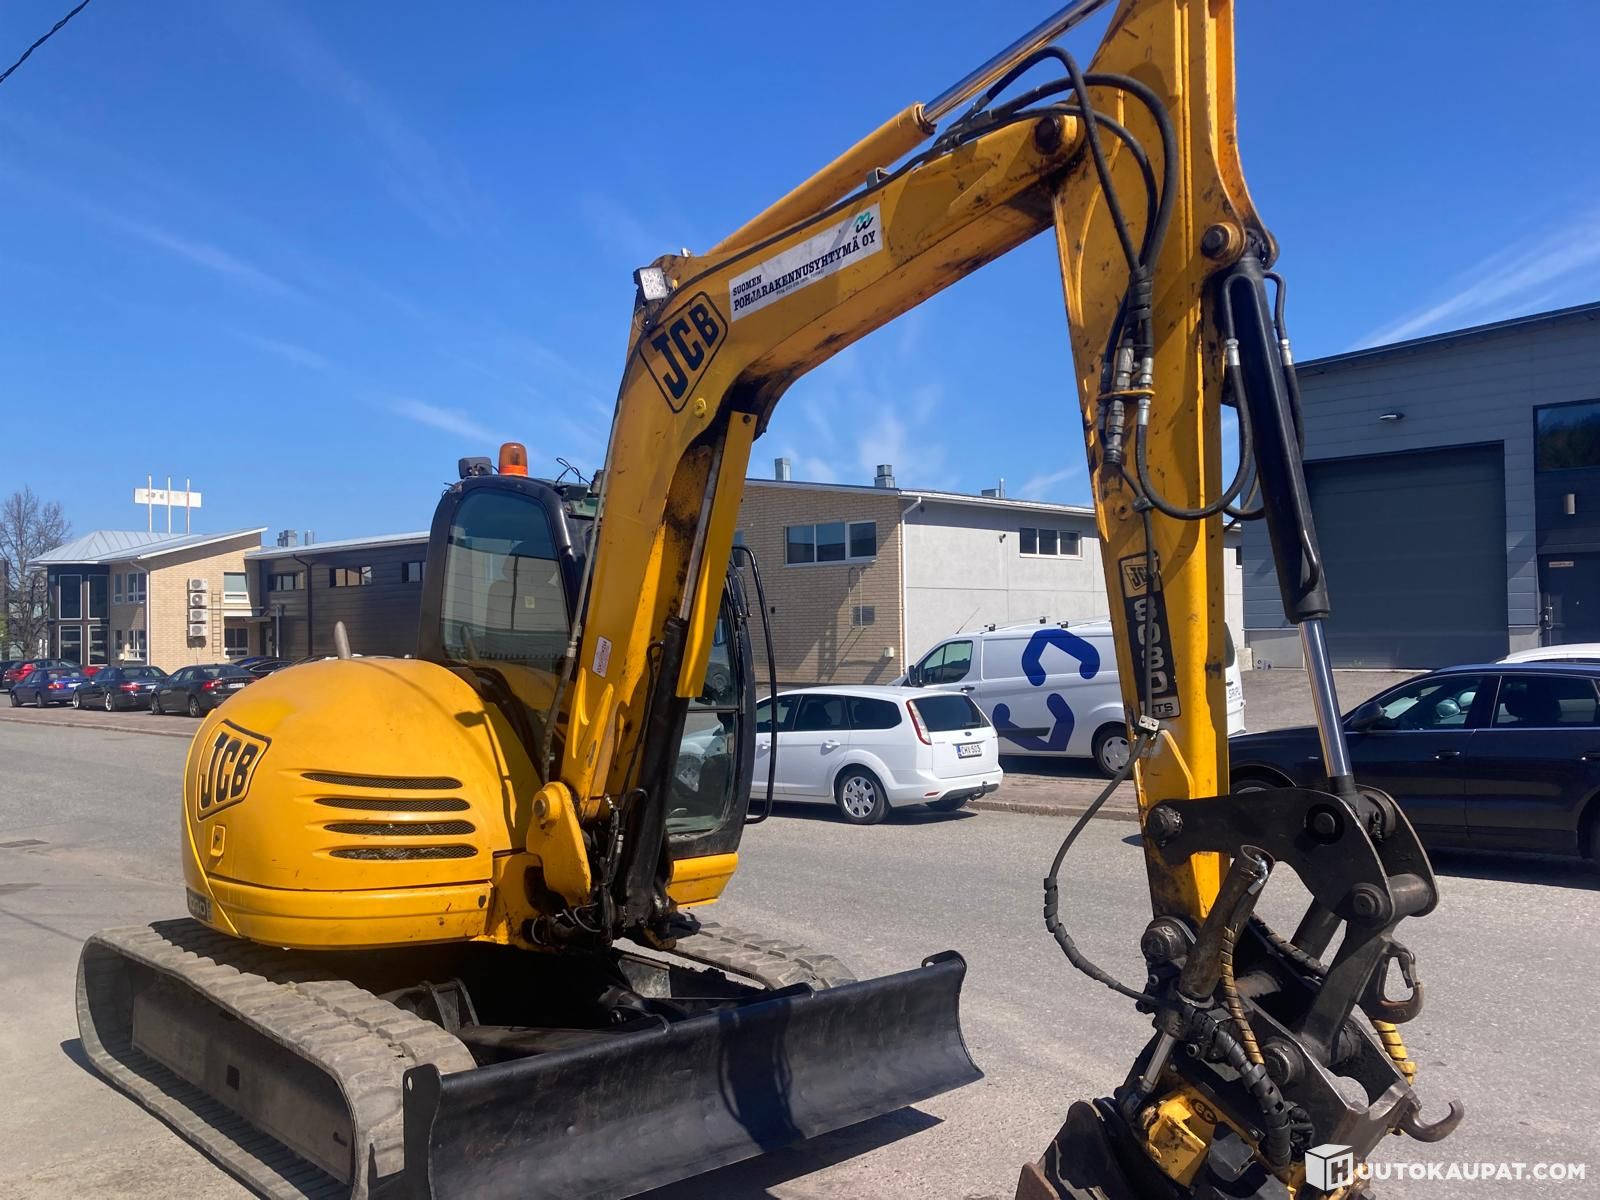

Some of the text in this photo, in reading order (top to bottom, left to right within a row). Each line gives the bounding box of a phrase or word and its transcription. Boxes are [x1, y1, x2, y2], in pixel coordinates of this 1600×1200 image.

[733, 275, 762, 297] SUOMEN
[734, 235, 860, 311] POHJARAKENNUSYHTYMÄ
[862, 230, 876, 247] OY
[651, 303, 719, 400] JCB
[1130, 566, 1152, 587] JC
[200, 731, 259, 810] JCB
